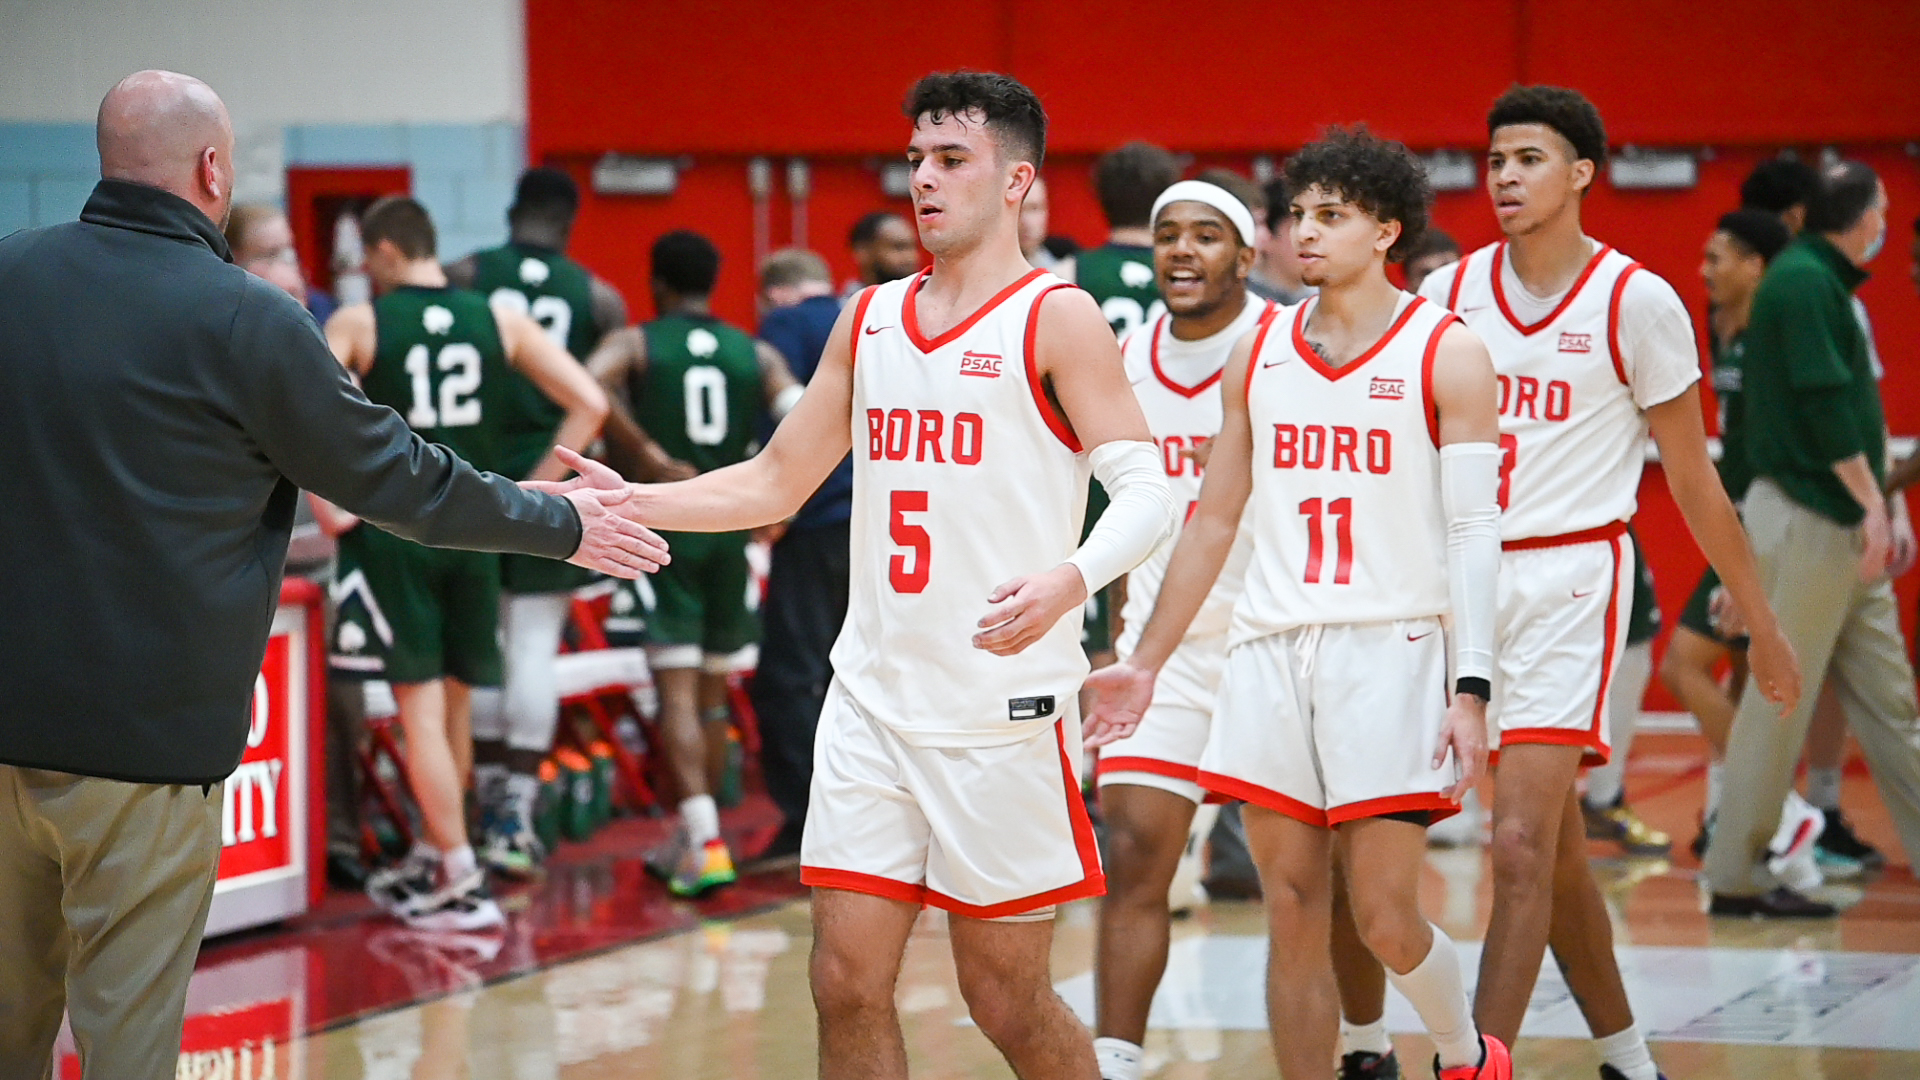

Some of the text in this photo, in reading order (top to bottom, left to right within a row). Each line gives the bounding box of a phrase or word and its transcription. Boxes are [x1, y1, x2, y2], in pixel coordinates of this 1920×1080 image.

[405, 343, 482, 428] 12
[961, 357, 1002, 373] PSAC
[1497, 373, 1571, 422] ORO
[684, 366, 728, 446] 0
[866, 408, 982, 465] BORO
[1273, 423, 1391, 475] BORO
[889, 490, 930, 593] 5
[1299, 497, 1352, 584] 11
